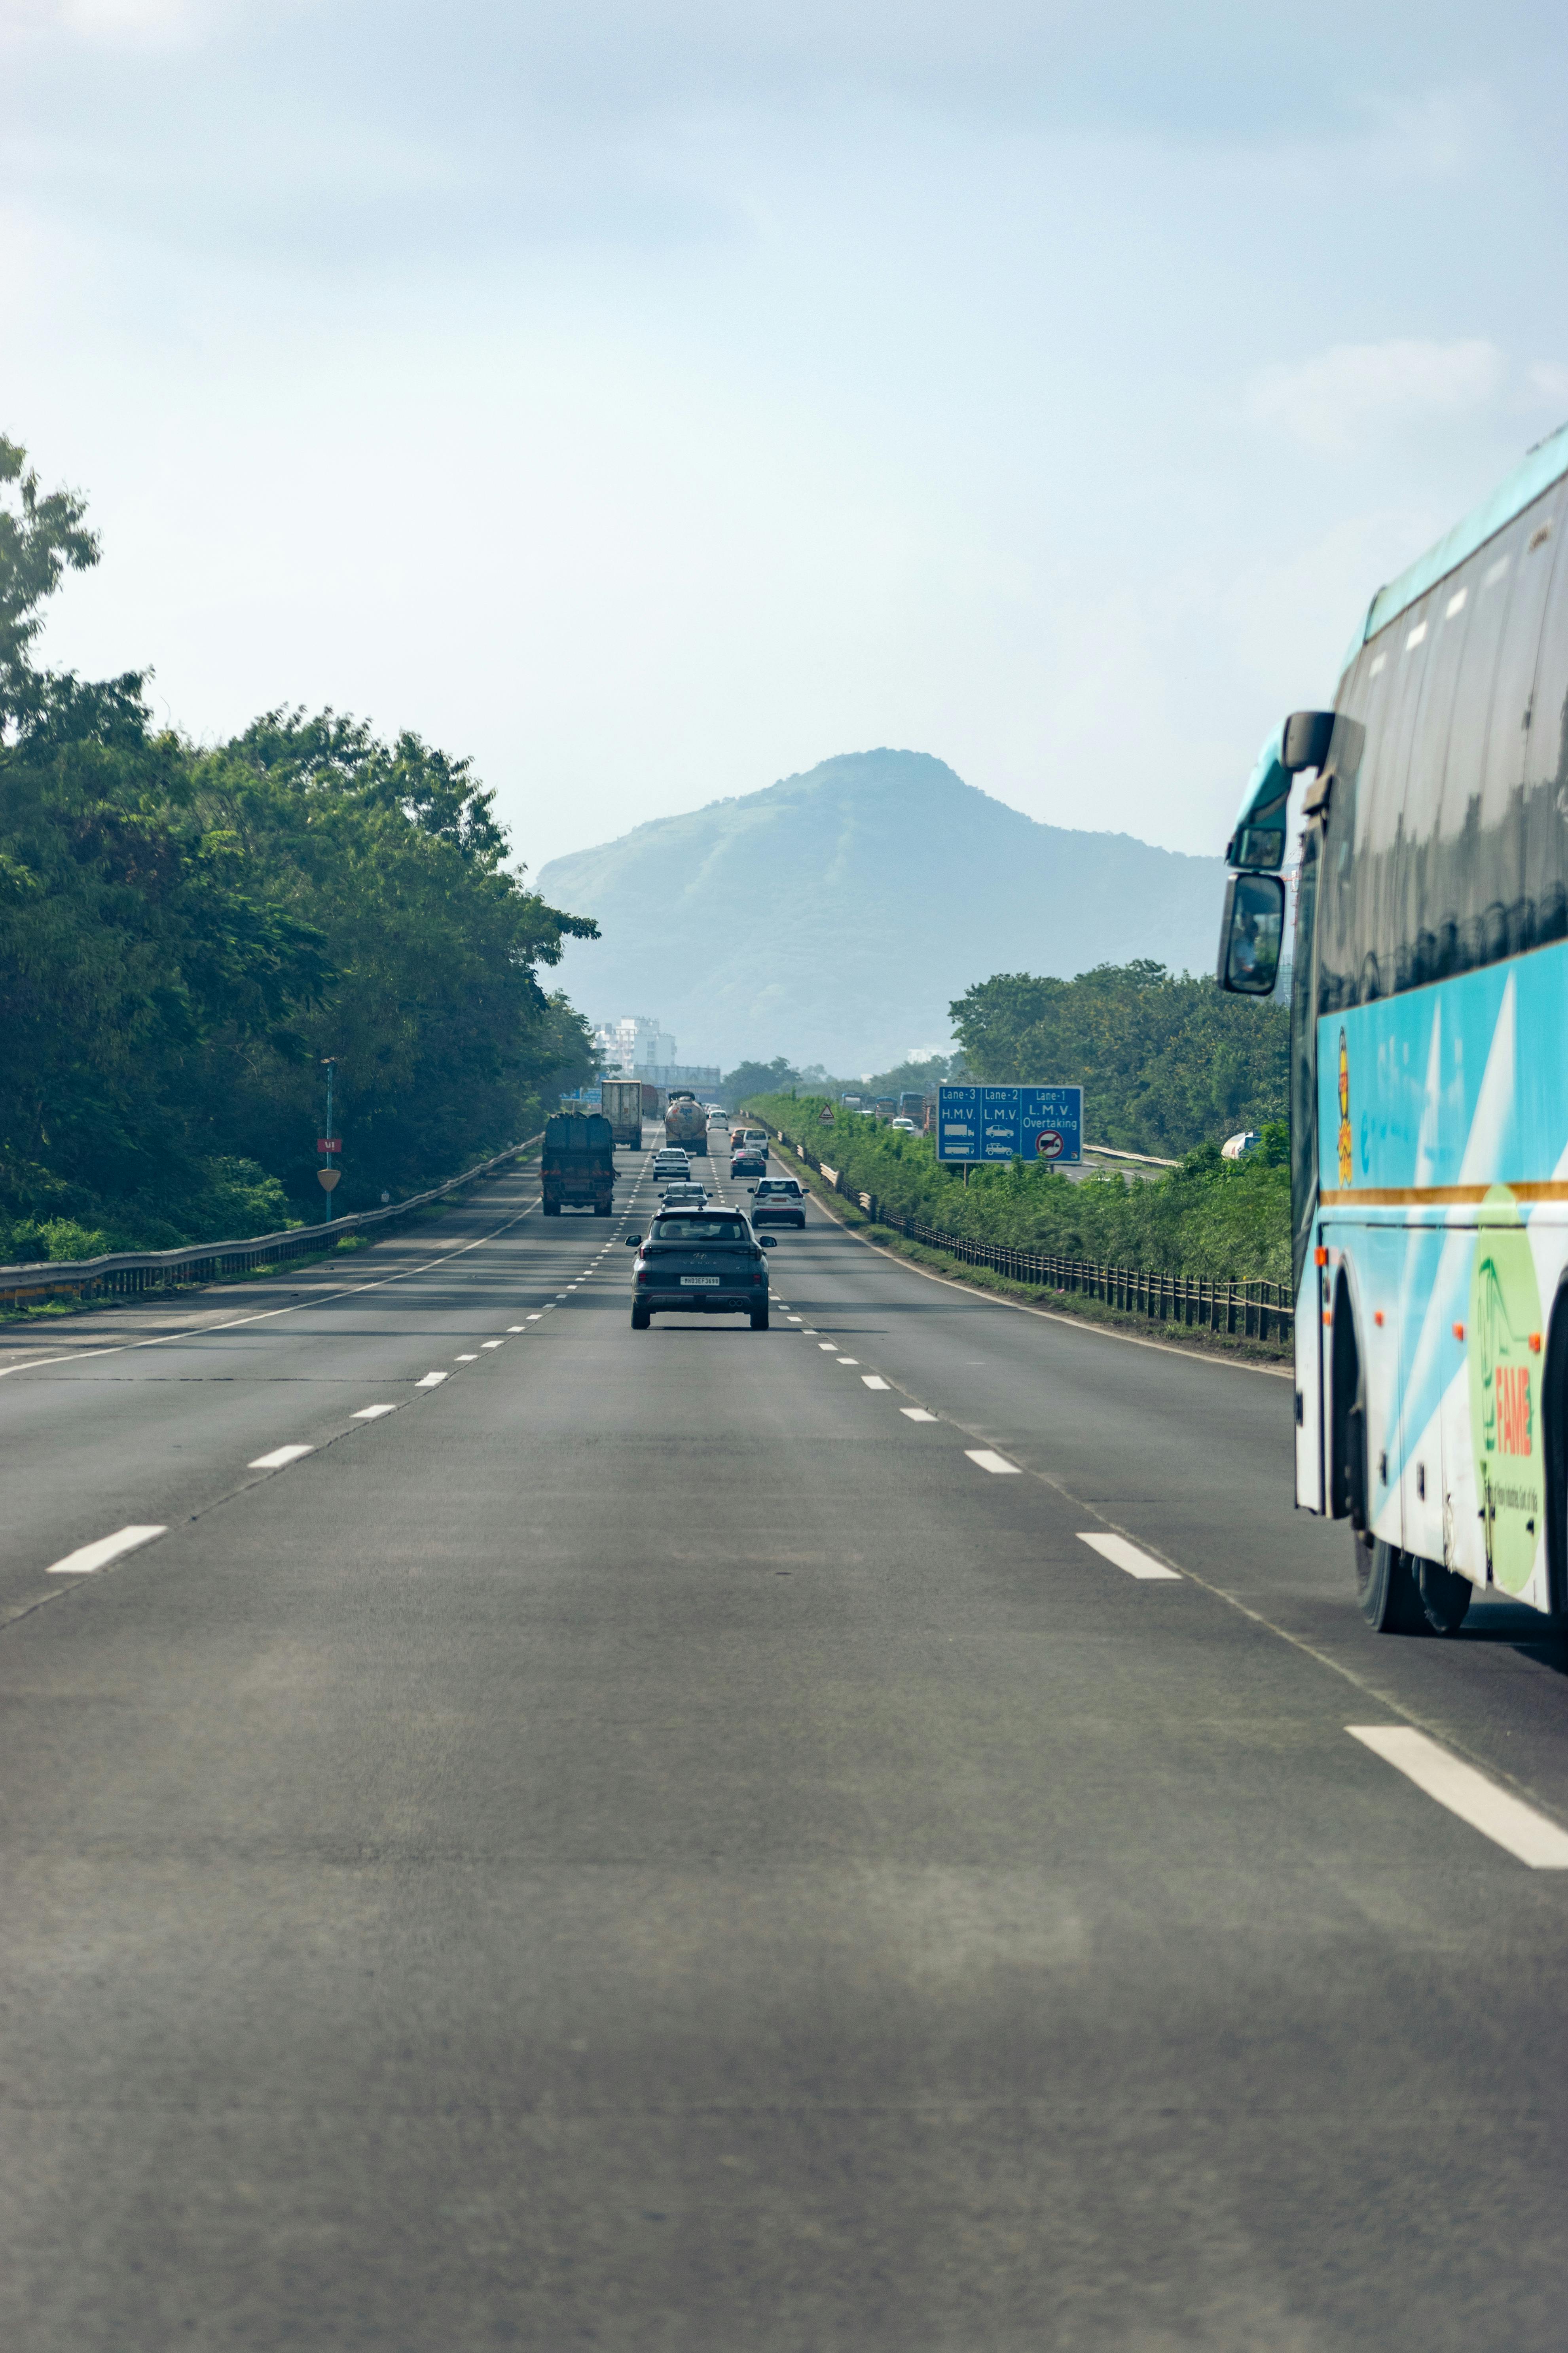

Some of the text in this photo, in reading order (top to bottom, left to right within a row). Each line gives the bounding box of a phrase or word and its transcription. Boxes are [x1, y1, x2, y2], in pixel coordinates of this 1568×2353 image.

[942, 1109, 975, 1119] H.M.V.
[984, 1109, 1019, 1120] L.M.V.
[1023, 1117, 1077, 1130] Overtaking
[1496, 1366, 1531, 1458] FAME
